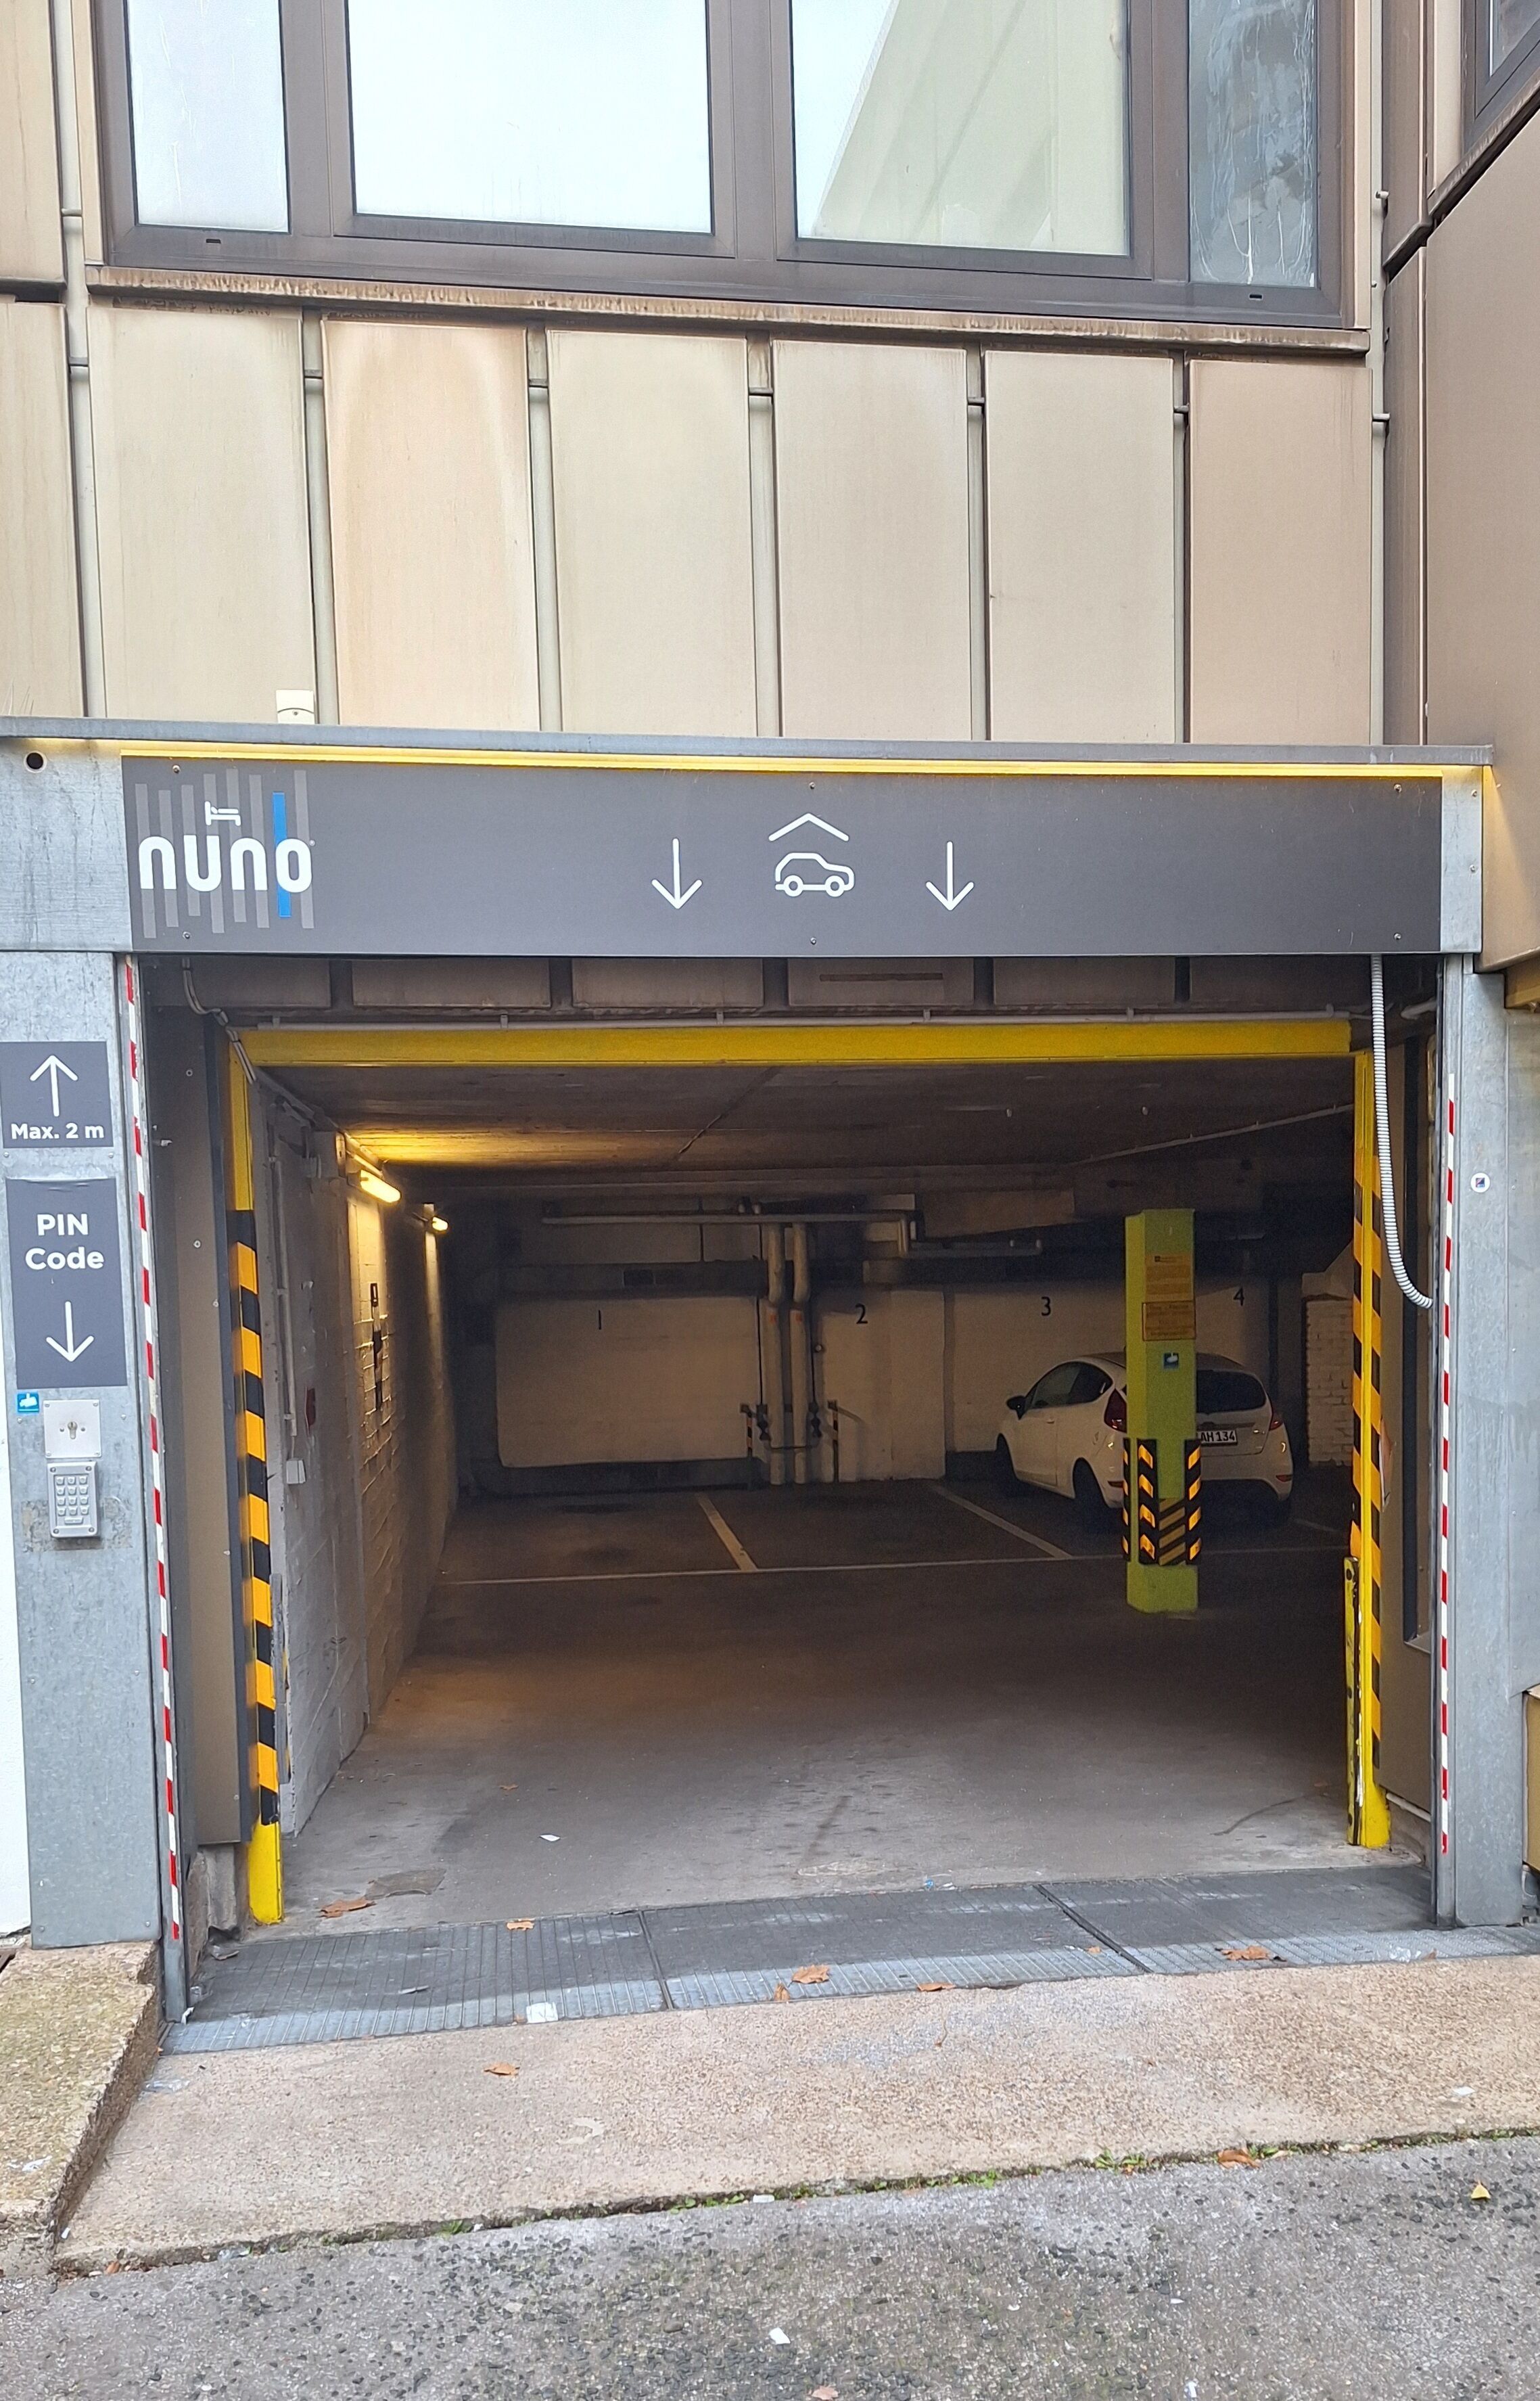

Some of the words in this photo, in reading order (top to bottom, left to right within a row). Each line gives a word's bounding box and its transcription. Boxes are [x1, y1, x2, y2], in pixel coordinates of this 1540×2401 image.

[139, 835, 312, 893] nuno
[11, 1123, 60, 1139] Max.
[66, 1122, 78, 1139] 2
[85, 1124, 104, 1139] m
[37, 1214, 89, 1236] PIN
[26, 1246, 104, 1270] Code
[1041, 1296, 1051, 1316] 3
[1233, 1287, 1245, 1306] 4
[855, 1303, 868, 1324] 2
